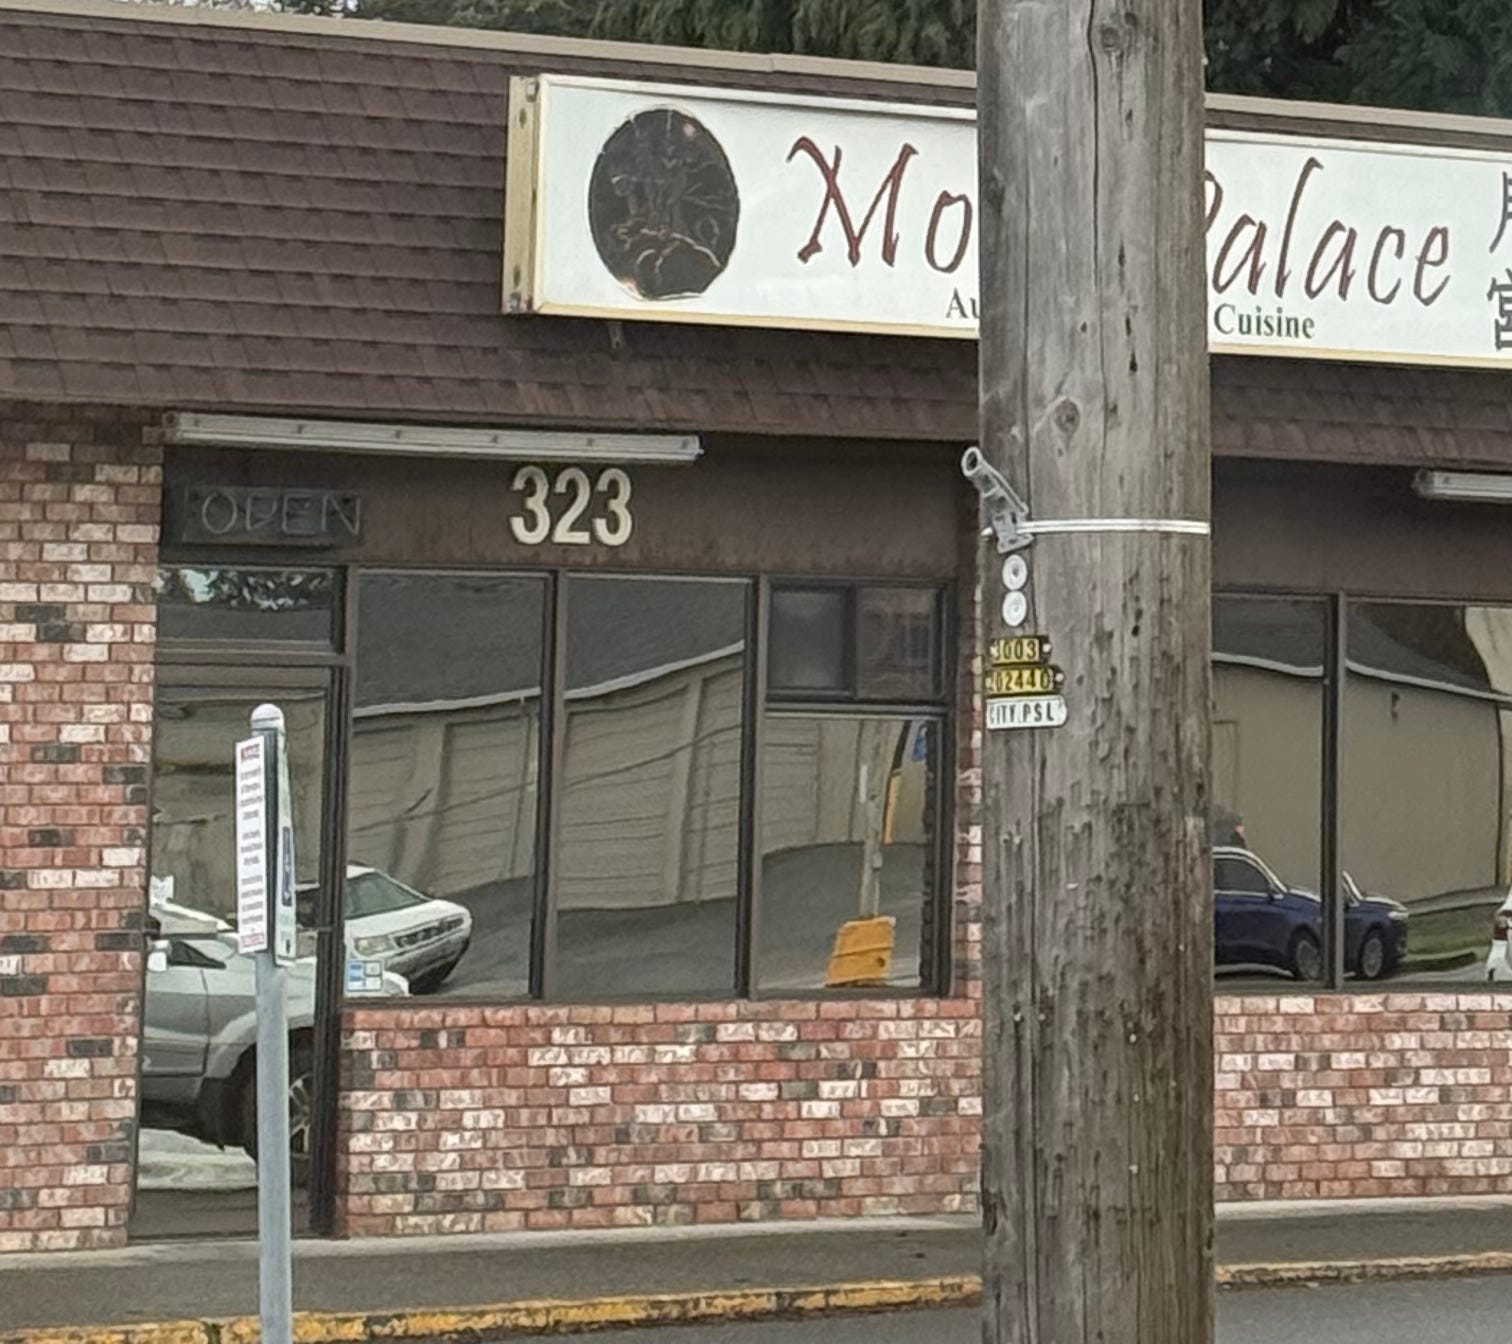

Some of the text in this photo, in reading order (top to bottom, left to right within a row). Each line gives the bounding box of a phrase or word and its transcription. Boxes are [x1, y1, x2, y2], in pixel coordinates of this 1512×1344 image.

[785, 135, 973, 274] Mo
[1213, 302, 1317, 340] Cuisine
[202, 492, 362, 536] OPEN
[509, 465, 633, 547] 323
